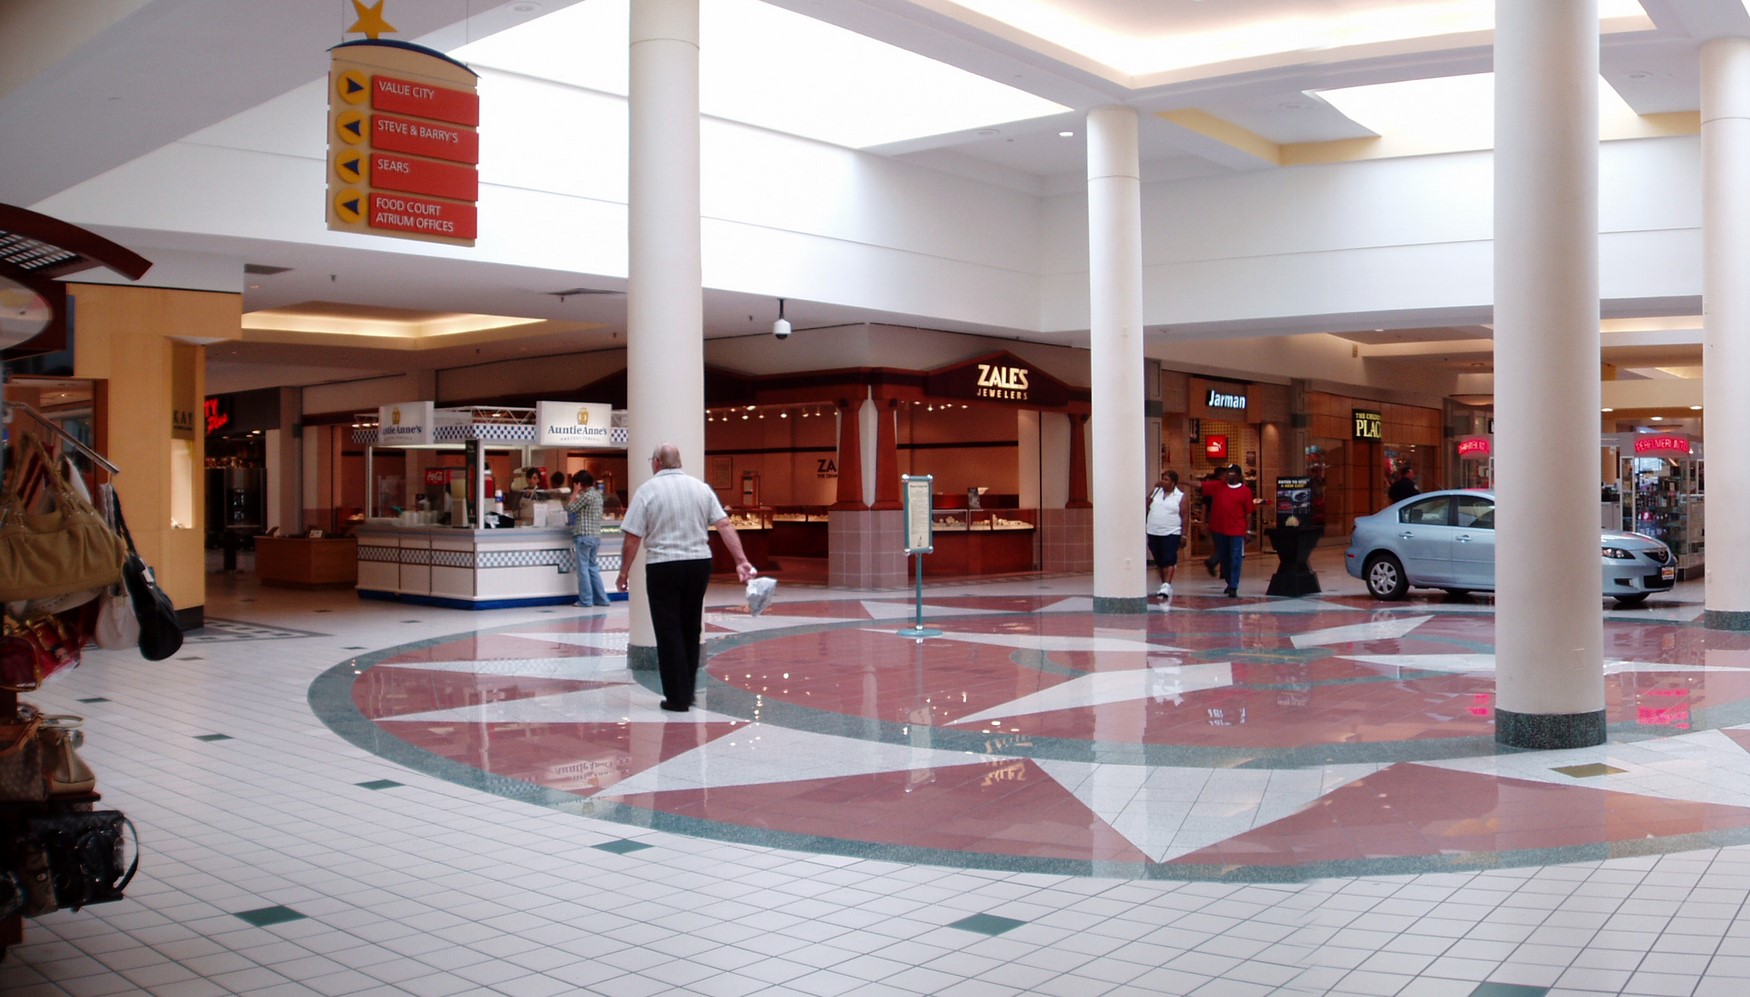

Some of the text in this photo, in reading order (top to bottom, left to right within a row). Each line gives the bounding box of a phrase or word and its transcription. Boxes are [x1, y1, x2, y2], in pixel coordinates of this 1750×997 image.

[378, 80, 435, 99] VALUE CITY
[378, 119, 459, 143] STEVE & BARRY'S
[378, 158, 409, 173] SEARS
[376, 197, 441, 216] FOOD COURT
[376, 212, 454, 232] ATRIUM OFFICES
[977, 364, 1028, 390] ZALES
[977, 388, 1028, 400] JEWELERS
[1208, 390, 1246, 409] Jarman
